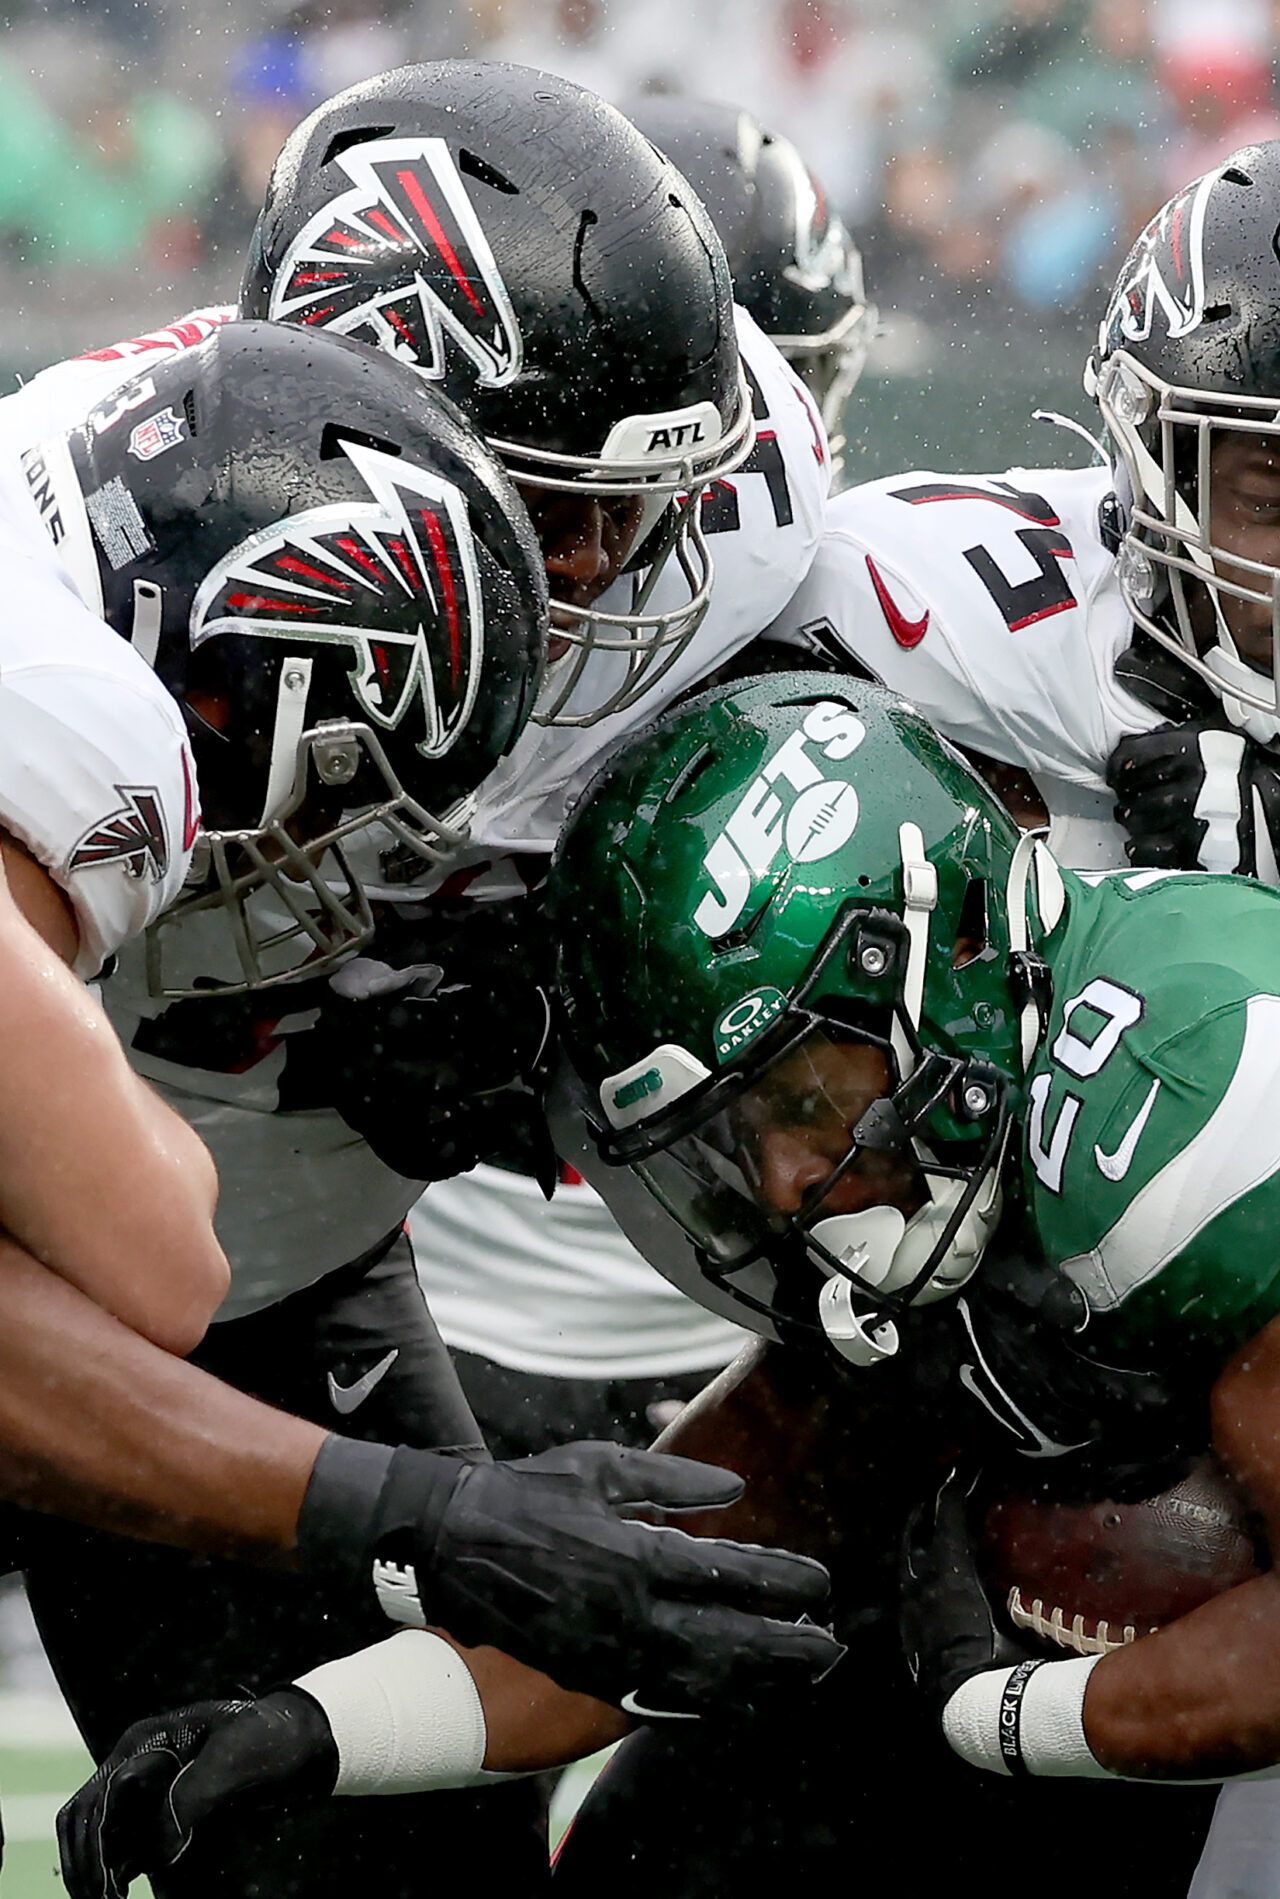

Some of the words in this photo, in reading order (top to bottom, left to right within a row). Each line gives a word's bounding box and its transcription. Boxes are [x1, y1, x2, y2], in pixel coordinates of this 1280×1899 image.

[137, 420, 164, 454] NFL
[646, 422, 705, 453] ATL
[693, 701, 867, 938] JETS
[718, 998, 783, 1056] OAKLEY
[1028, 975, 1147, 1195] 20
[1001, 1698, 1018, 1757] BLACK
